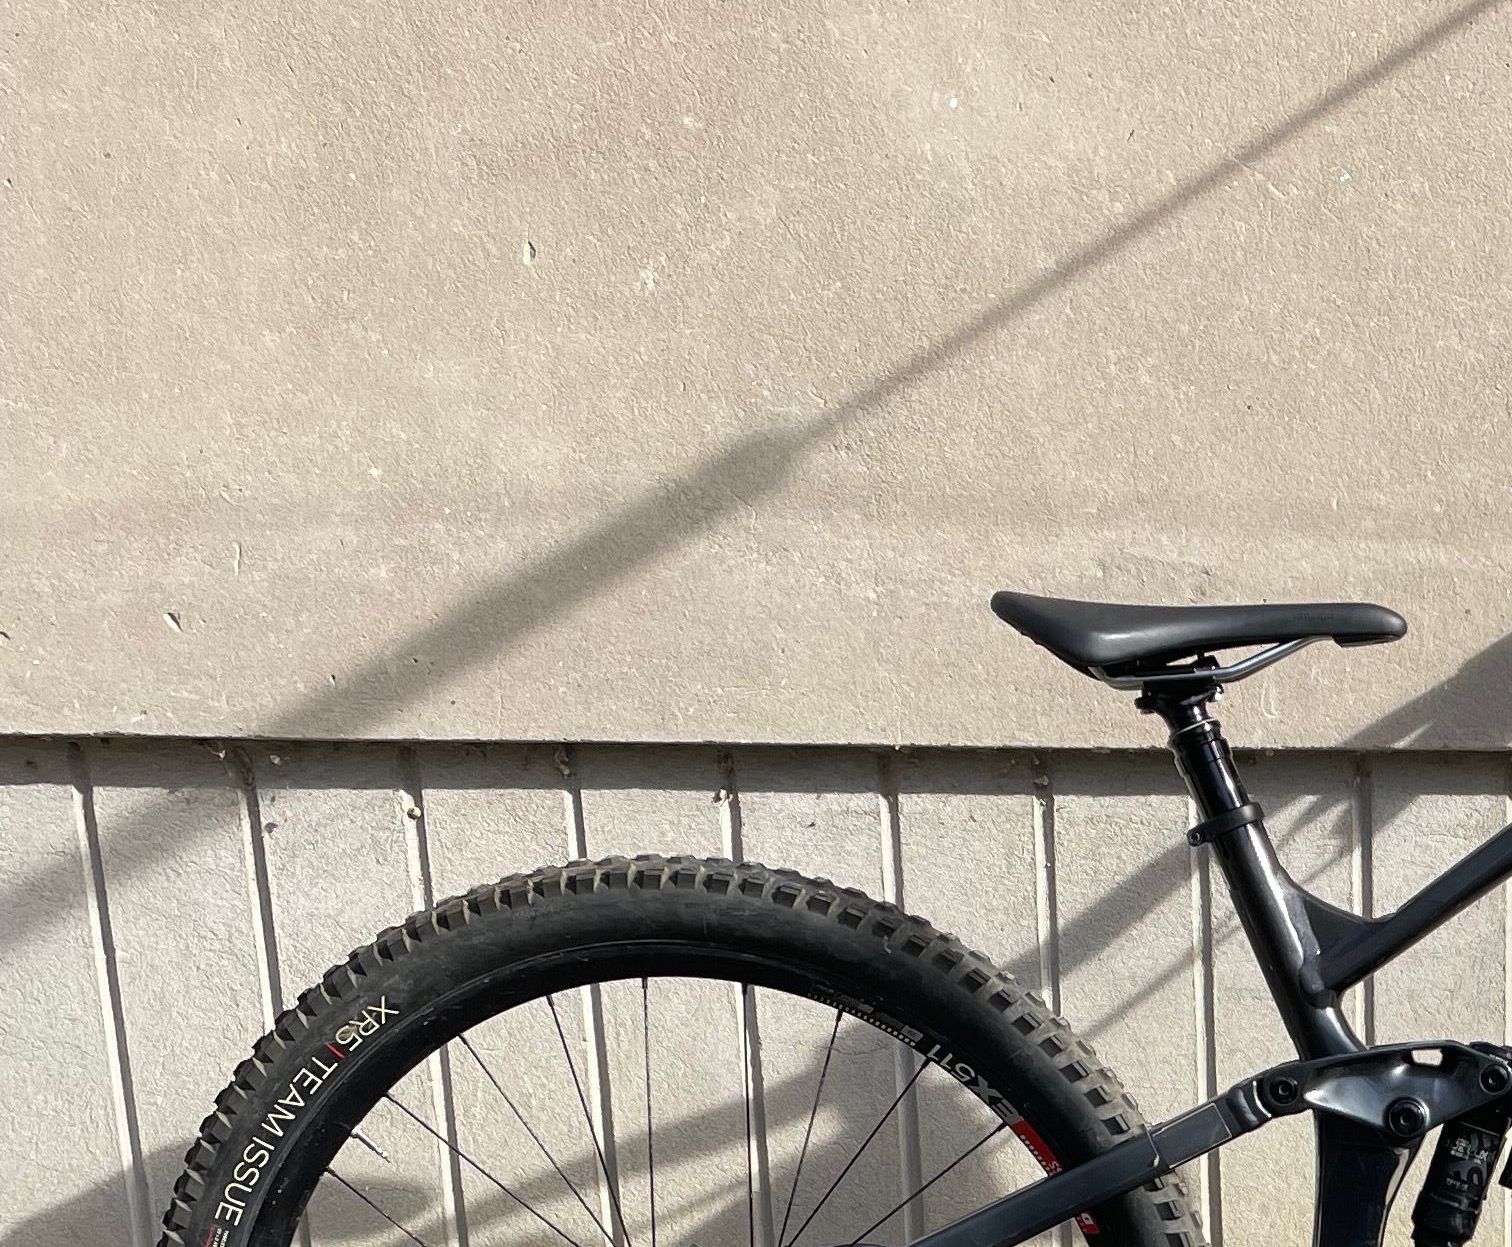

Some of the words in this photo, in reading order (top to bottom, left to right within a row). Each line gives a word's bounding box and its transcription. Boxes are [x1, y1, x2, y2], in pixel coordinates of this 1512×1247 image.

[335, 995, 400, 1051] XR5
[261, 1056, 338, 1137] TEAM
[926, 1043, 1025, 1126] EX511
[214, 1136, 275, 1226] ISSUE
